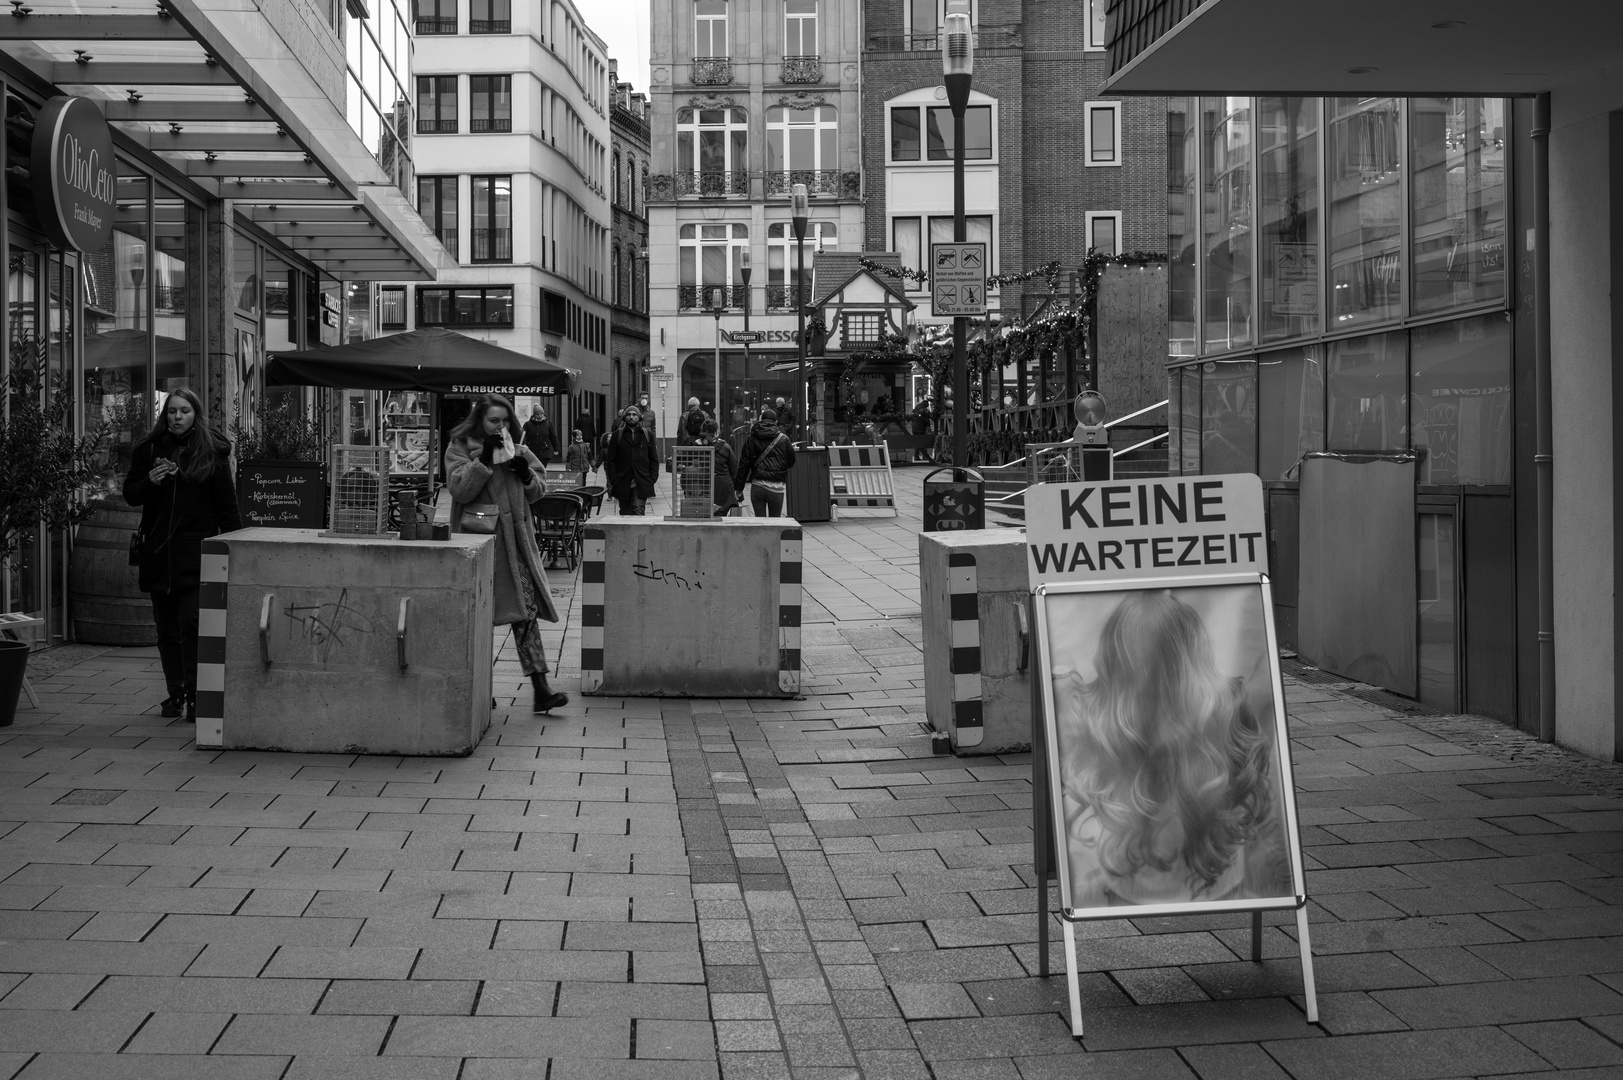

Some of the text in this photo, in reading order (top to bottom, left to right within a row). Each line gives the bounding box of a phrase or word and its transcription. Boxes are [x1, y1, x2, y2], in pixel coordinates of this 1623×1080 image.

[63, 133, 114, 205] OlioCeto
[74, 202, 102, 232] Frank Mayer
[451, 384, 555, 394] STARBUCKS COFFEE
[1060, 480, 1226, 529] KEINE
[1030, 532, 1262, 574] WARTEZEIT
